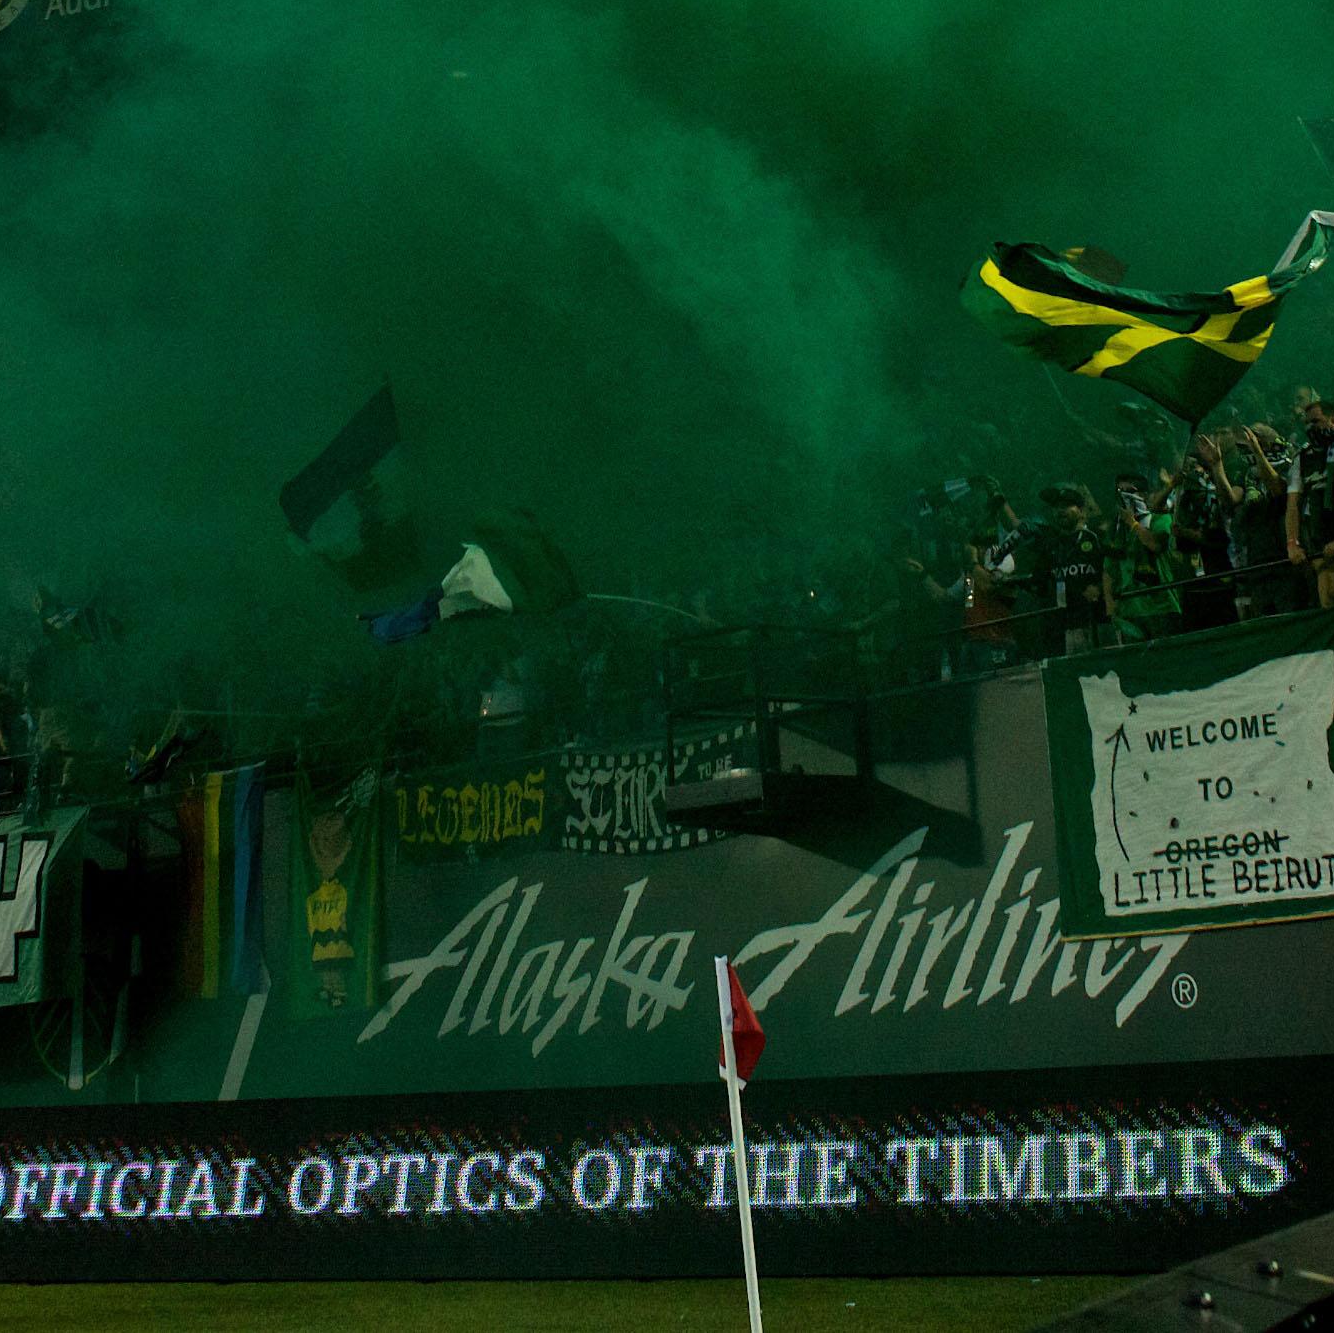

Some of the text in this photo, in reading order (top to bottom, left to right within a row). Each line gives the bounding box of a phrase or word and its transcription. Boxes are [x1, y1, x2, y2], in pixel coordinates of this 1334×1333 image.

[1146, 713, 1278, 753] WELCOME
[1198, 776, 1234, 802] TO
[1164, 829, 1284, 864] OREGON
[1114, 863, 1217, 908] LITTLE
[356, 876, 696, 1059] Alaska
[286, 1149, 547, 1215] OPTICS
[571, 1147, 672, 1211] OF
[693, 1142, 859, 1209] THE
[884, 1124, 1289, 1204] TIMBERS
